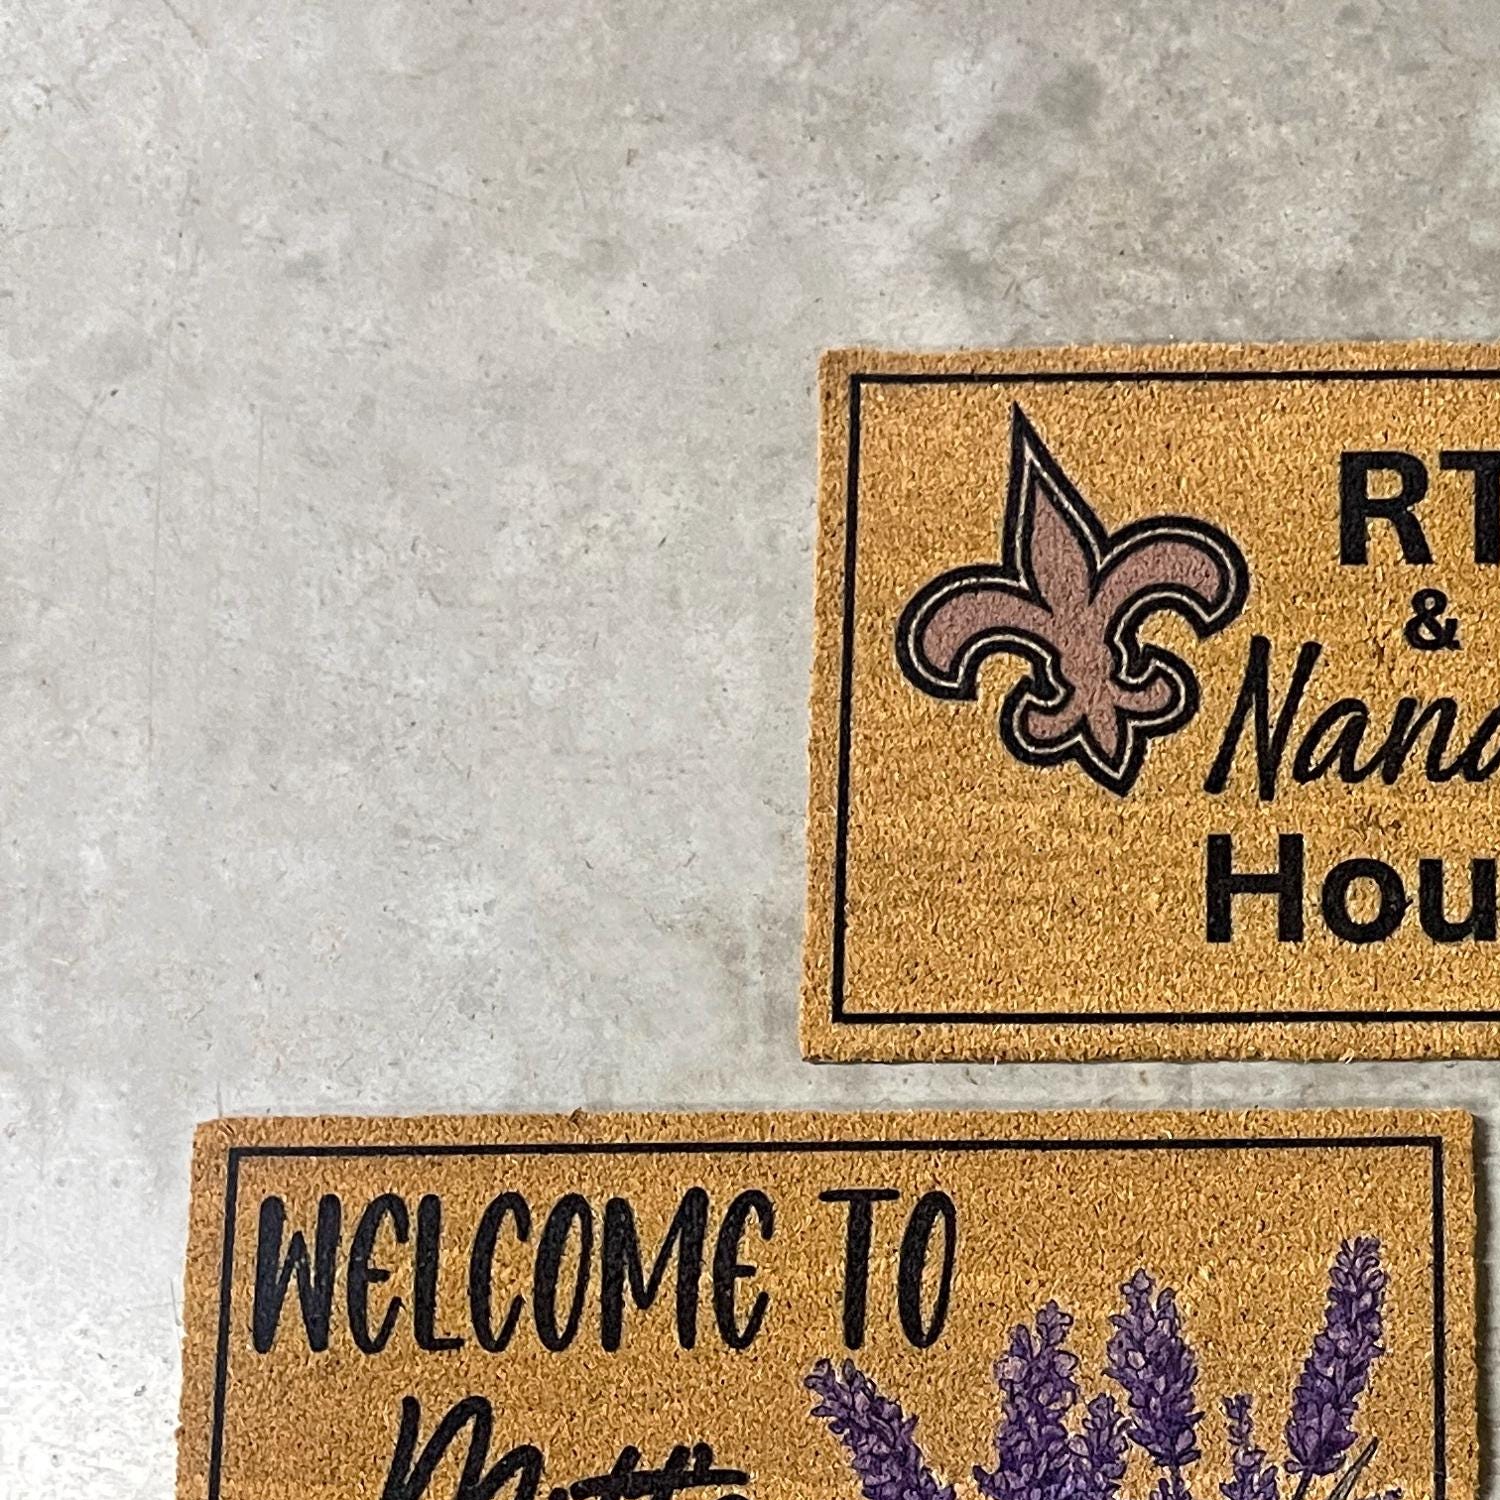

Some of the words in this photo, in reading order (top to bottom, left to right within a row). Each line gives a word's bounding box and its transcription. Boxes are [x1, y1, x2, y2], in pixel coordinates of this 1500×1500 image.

[1404, 589, 1460, 651] &
[253, 1187, 774, 1354] WELCOME
[819, 1189, 956, 1350] TO
